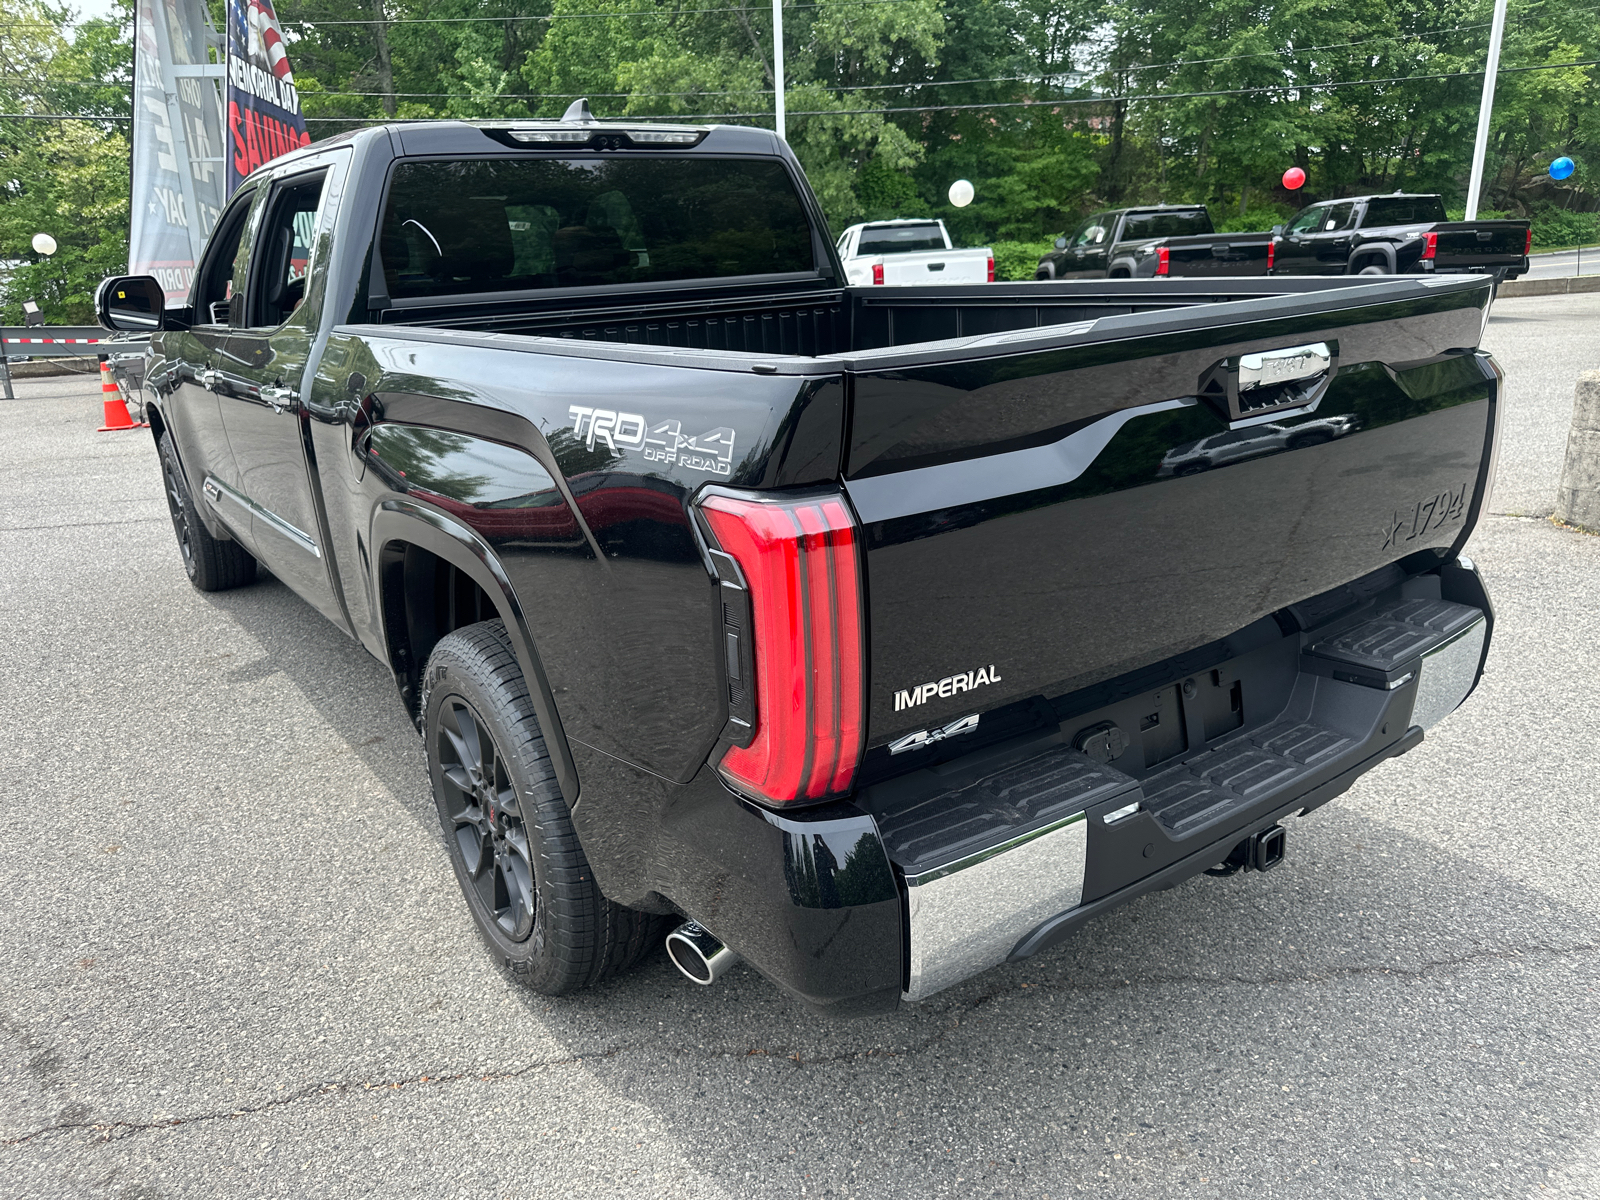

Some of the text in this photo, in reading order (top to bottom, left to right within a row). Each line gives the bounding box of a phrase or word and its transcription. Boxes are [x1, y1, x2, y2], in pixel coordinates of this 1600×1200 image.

[229, 54, 281, 107] MEMORIAL
[279, 80, 299, 116] DAY
[229, 101, 312, 177] SAVIN
[569, 404, 736, 463] TRD 4x4
[643, 447, 732, 476] OFF ROAD
[1404, 482, 1467, 541] 1794
[892, 664, 1002, 712] IMPERIAL
